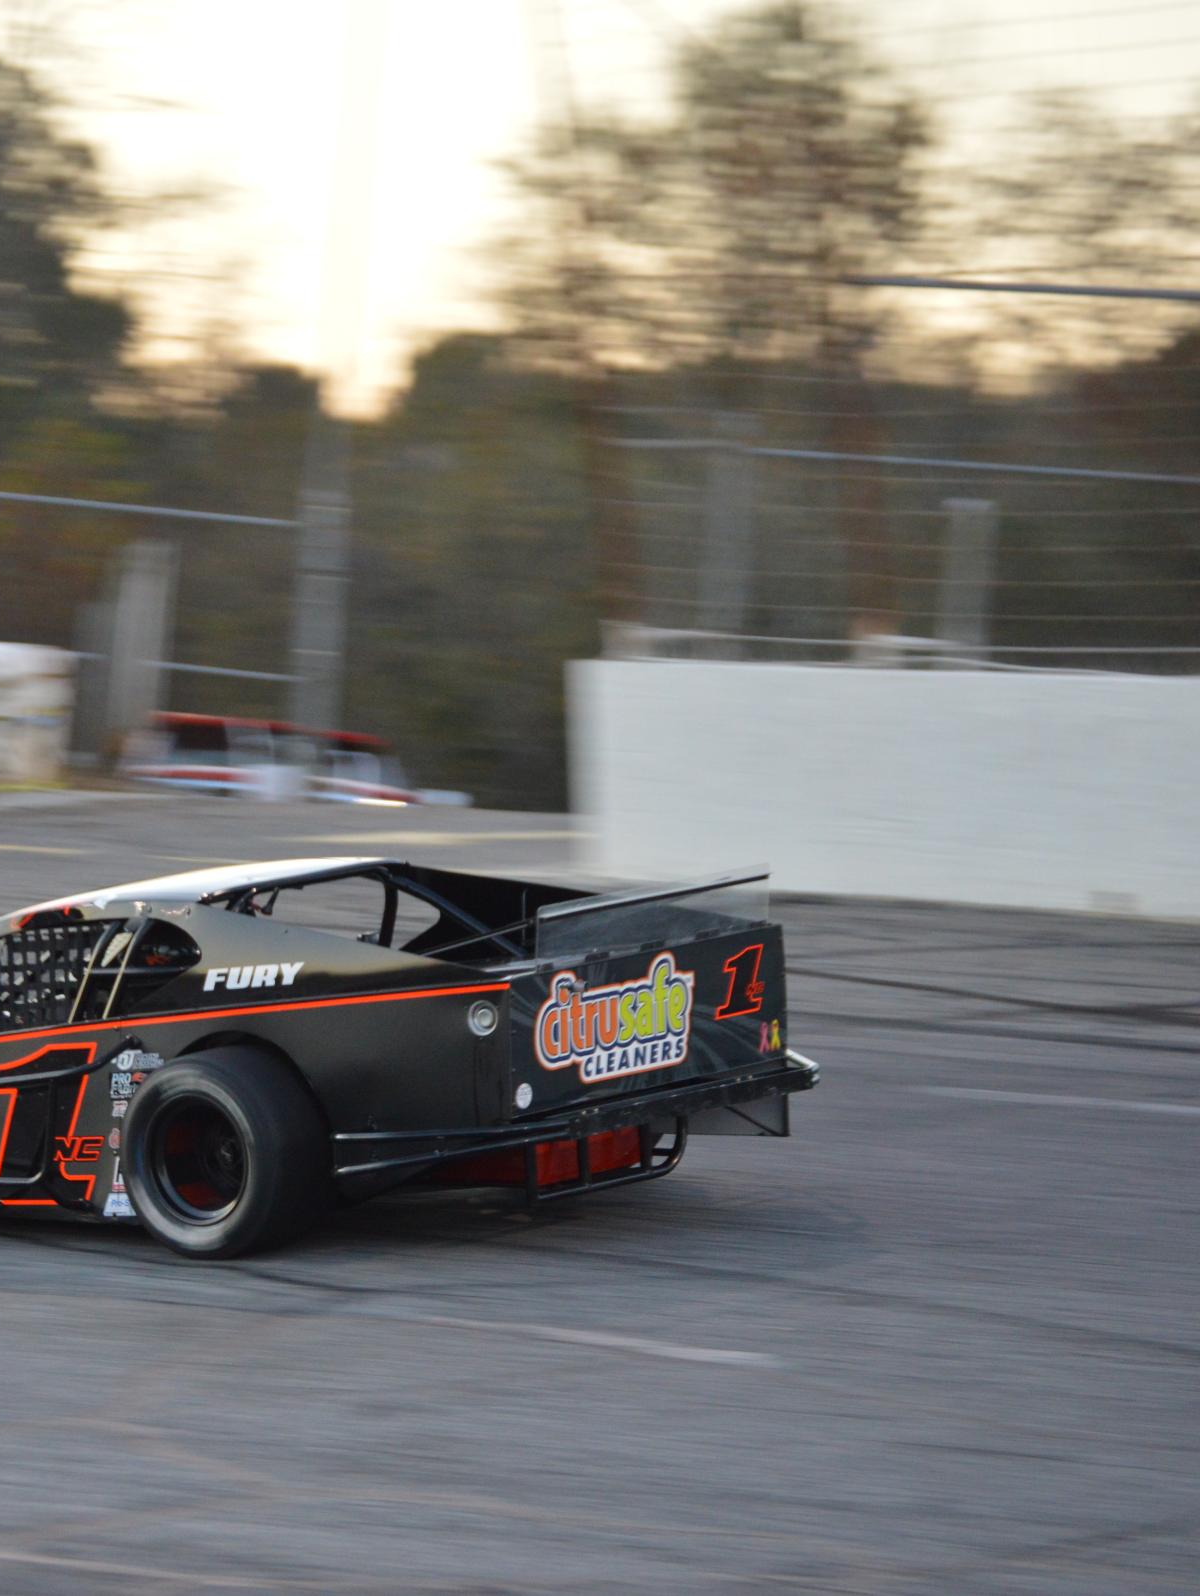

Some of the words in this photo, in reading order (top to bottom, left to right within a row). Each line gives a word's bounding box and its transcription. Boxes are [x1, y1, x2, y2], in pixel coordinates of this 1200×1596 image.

[203, 962, 304, 992] FURY
[714, 943, 765, 1022] 1
[543, 963, 687, 1058] citrusafe
[583, 1038, 684, 1077] CLEANERS
